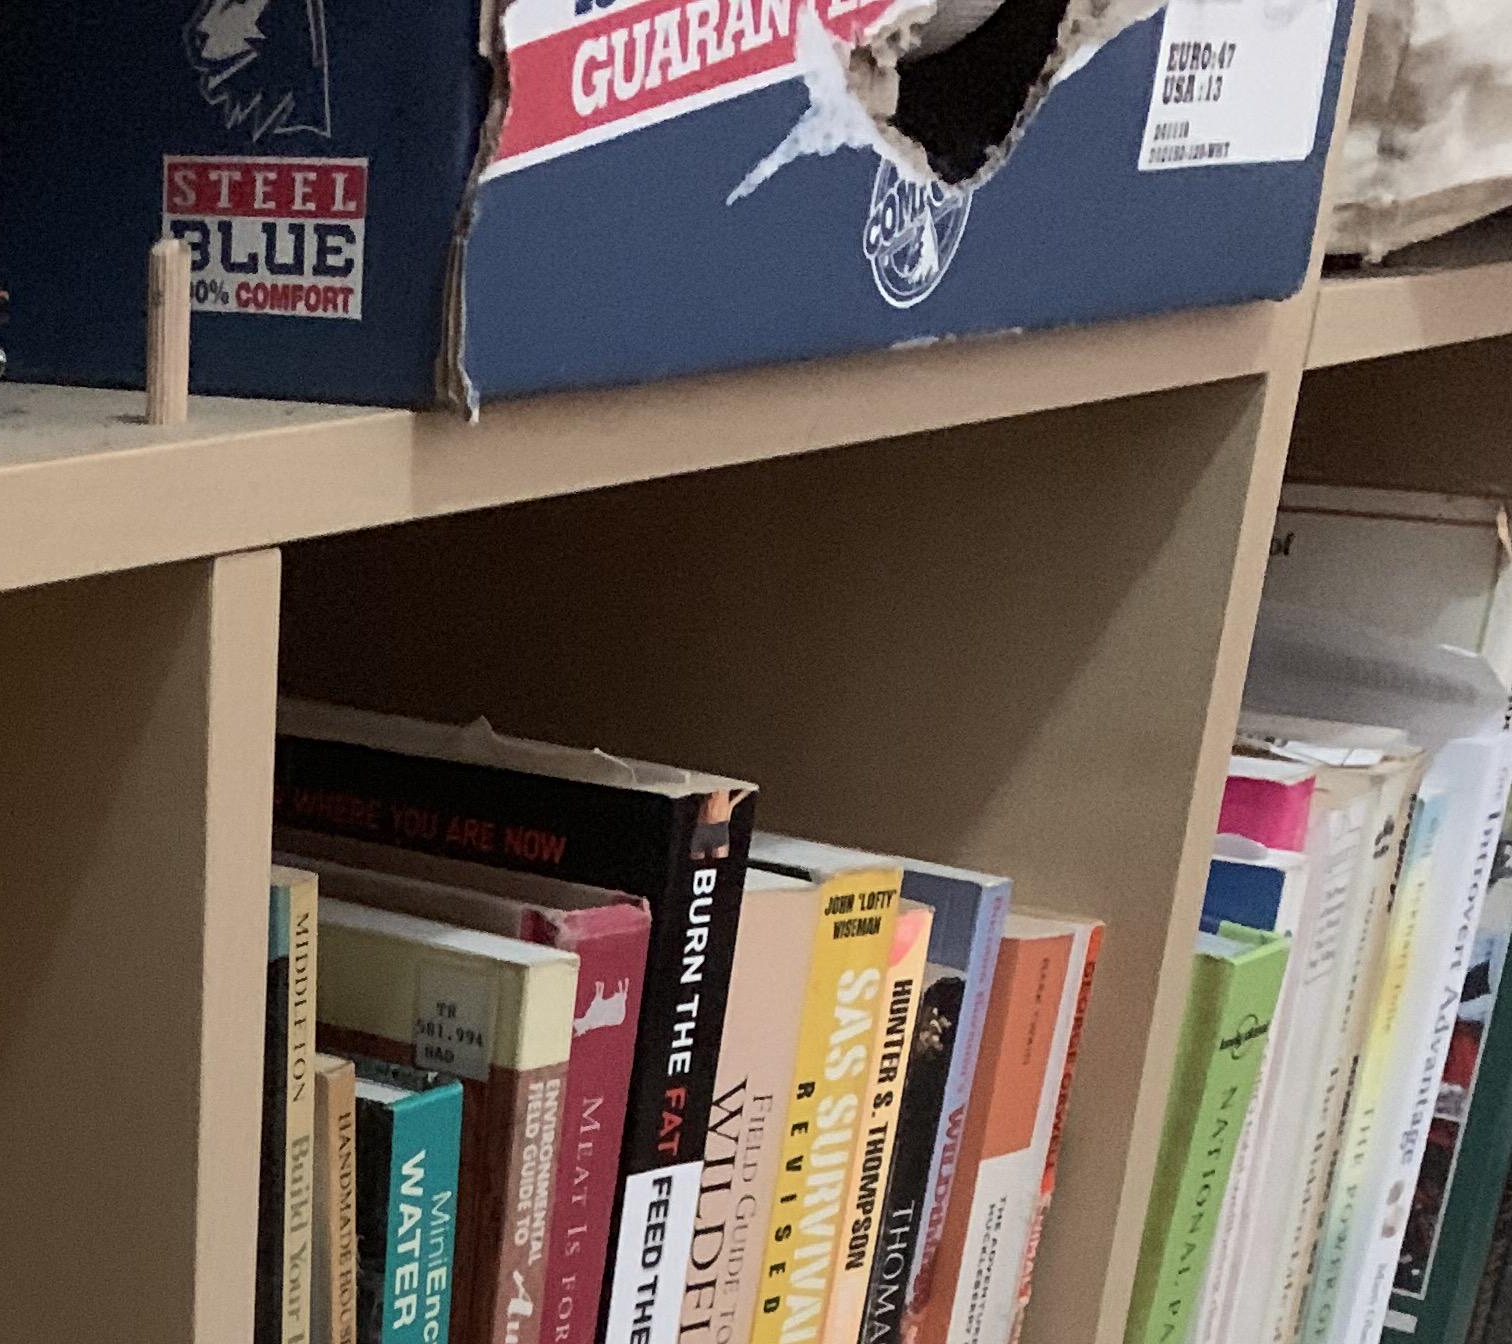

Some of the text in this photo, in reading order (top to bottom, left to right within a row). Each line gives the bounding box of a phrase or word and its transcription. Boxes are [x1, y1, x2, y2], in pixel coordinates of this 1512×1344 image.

[1162, 74, 1196, 105] USA
[1166, 40, 1237, 72] EURO:47
[172, 168, 358, 212] STEEL
[169, 219, 357, 277] BLUE
[235, 281, 355, 314] COMFORT
[392, 805, 440, 839] YOU
[446, 815, 495, 849] ARE
[504, 827, 568, 865] NOW
[680, 867, 717, 984] BURN
[825, 893, 854, 917] JOHN
[831, 916, 882, 940] WISEMAN
[1449, 811, 1502, 971] Introvert
[667, 994, 701, 1077] THE
[823, 967, 879, 1082] SAS
[656, 1086, 688, 1156] FAT
[1399, 985, 1461, 1166] Advantage
[514, 1081, 544, 1247] FIELD GUIDE TO
[844, 977, 914, 1271] HUNTER S. THOMPSON
[1353, 1107, 1375, 1166] THE
[289, 1135, 311, 1234] Build
[527, 1078, 561, 1267] ENVIRONMENTAL
[761, 1081, 816, 1314] REVISED
[1178, 1085, 1238, 1278] NATIONAL
[392, 1150, 426, 1331] WATER
[640, 1175, 674, 1271] FEED
[966, 1203, 996, 1334] HUCKLEBERRY
[1327, 1183, 1358, 1290] POWER
[287, 1250, 308, 1332] Your
[1314, 1302, 1332, 1337] OF
